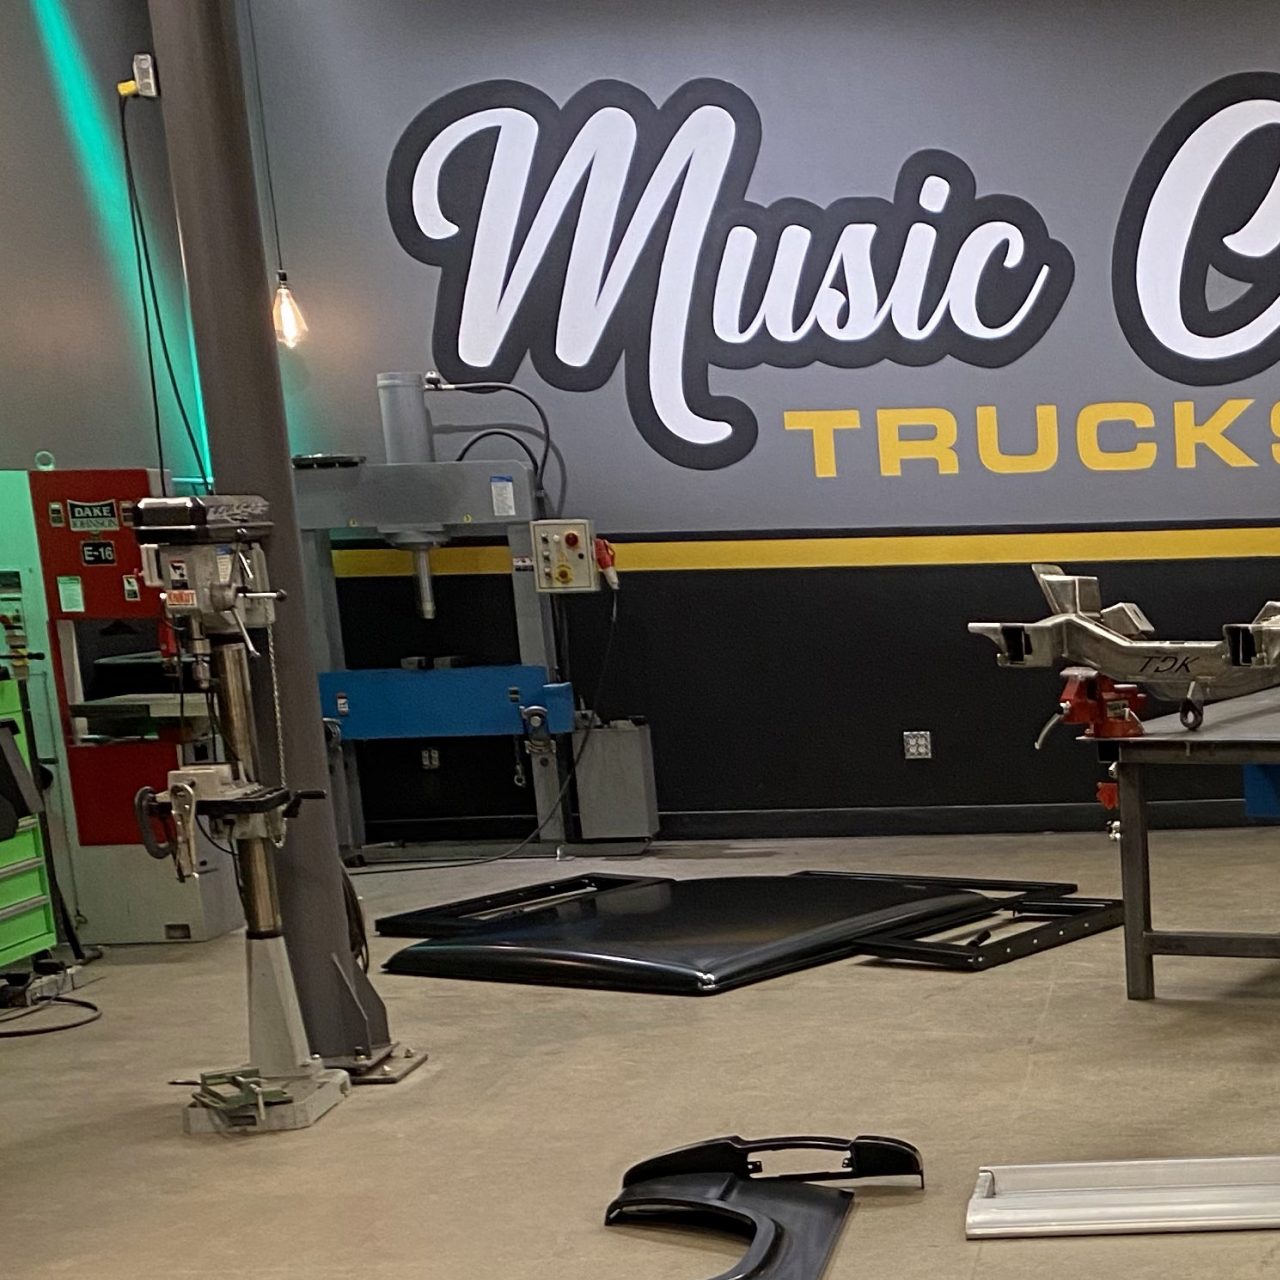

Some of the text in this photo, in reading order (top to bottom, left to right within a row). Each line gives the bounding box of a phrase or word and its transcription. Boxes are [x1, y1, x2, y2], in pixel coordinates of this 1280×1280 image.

[411, 105, 1050, 444] Music
[74, 506, 111, 518] DAKE
[84, 546, 113, 560] E-16
